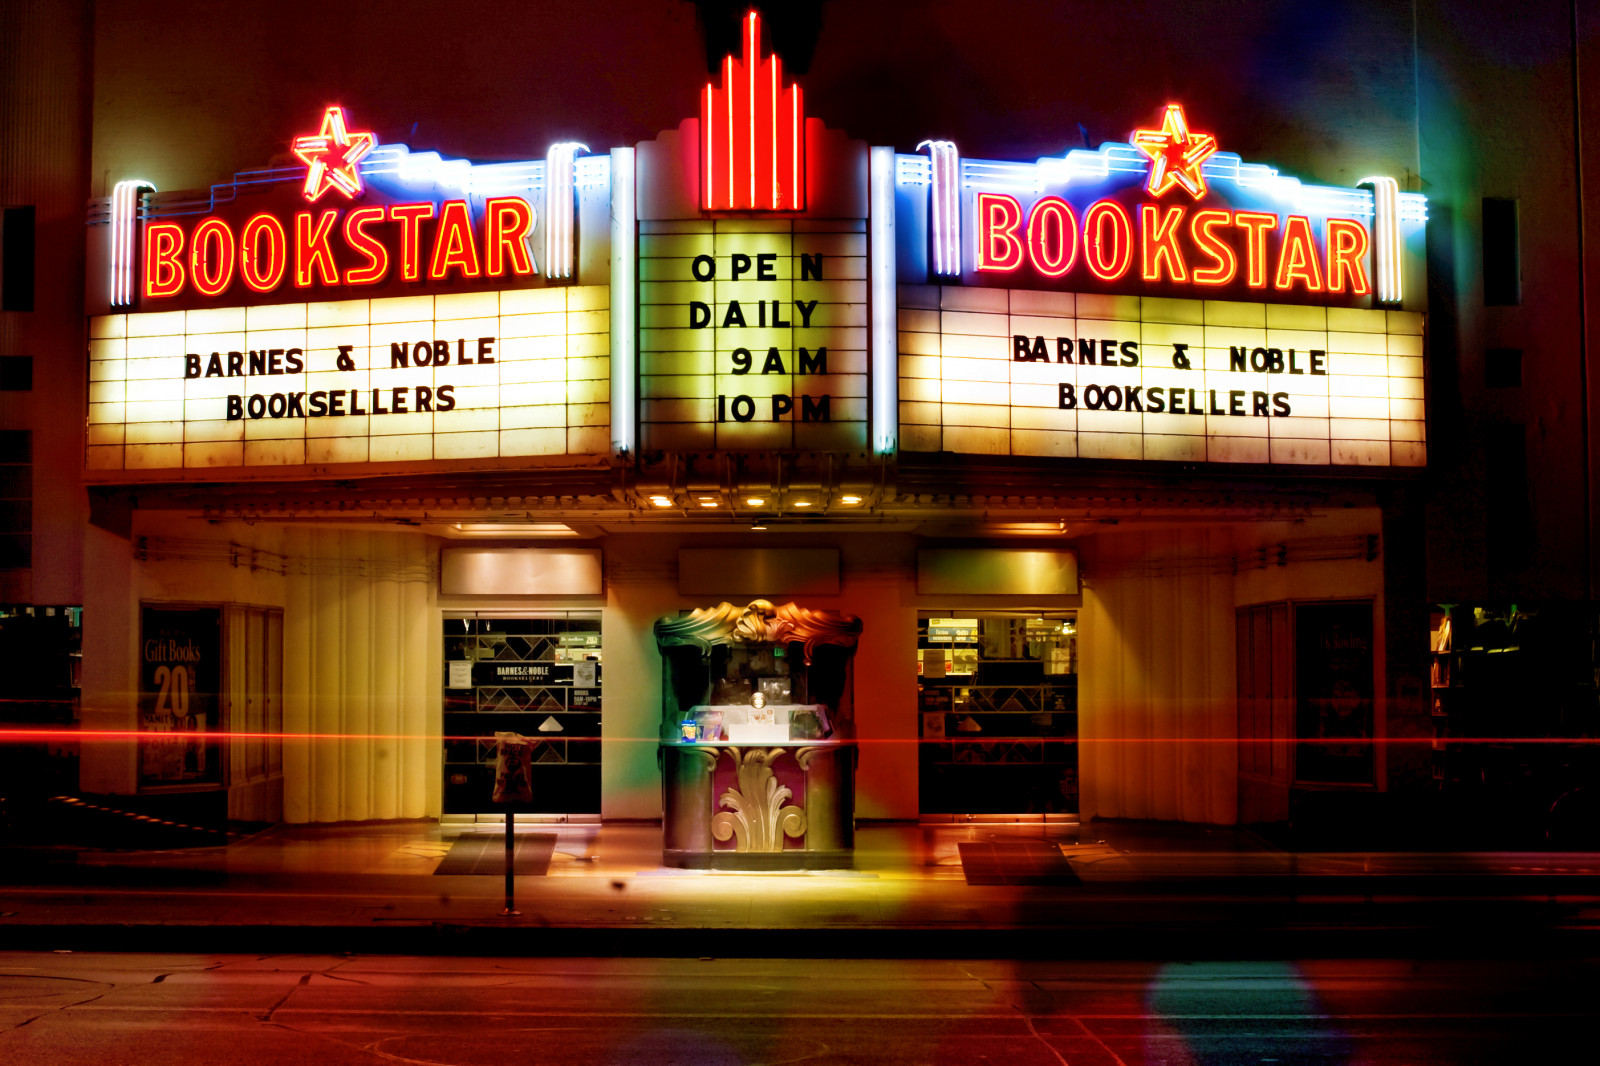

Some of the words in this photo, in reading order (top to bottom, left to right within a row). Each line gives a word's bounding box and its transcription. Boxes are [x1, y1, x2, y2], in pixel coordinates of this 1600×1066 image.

[144, 197, 537, 298] BOOKSTAR
[977, 192, 1371, 295] BOOKSTAR
[692, 253, 823, 282] OPEN
[690, 300, 818, 329] DAILY
[185, 347, 304, 379] BARNES
[336, 345, 355, 371] &
[391, 337, 496, 369] NOBLE
[1013, 335, 1139, 367] BARNES
[1172, 343, 1191, 370] &
[1230, 346, 1326, 375] NOBLE
[227, 385, 456, 421] BOOKSELLERS
[1058, 383, 1291, 418] BOOKSELLERS
[145, 638, 167, 662] Gift
[169, 637, 201, 662] Books
[154, 665, 189, 718] 20
